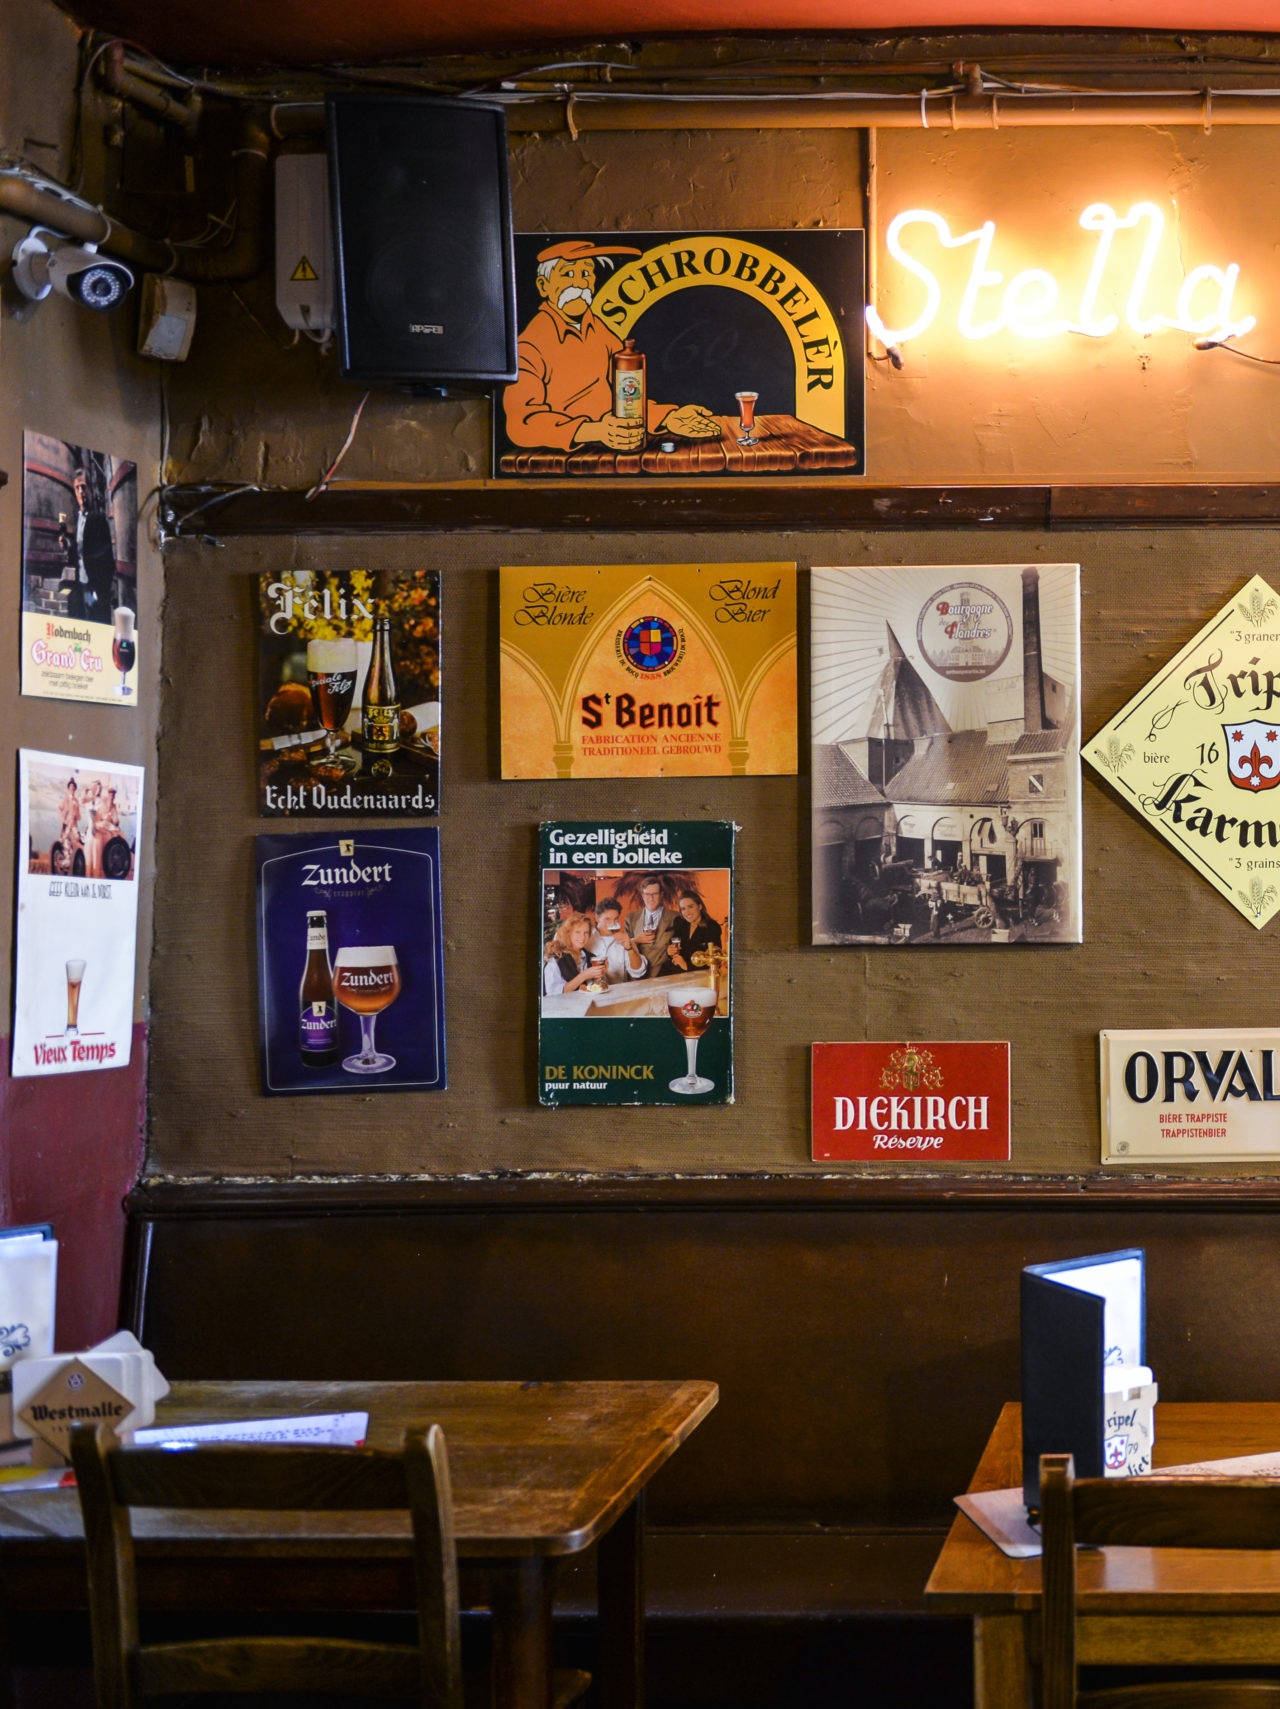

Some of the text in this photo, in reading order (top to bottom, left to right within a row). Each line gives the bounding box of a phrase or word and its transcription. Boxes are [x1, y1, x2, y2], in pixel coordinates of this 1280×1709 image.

[868, 203, 1256, 338] Stella
[600, 246, 838, 394] SCHROBBELÈR
[267, 582, 375, 635] Felix
[513, 582, 594, 626] Bière Blonde
[708, 579, 782, 624] Blond Bier
[46, 622, 91, 644] Rodenbach
[32, 639, 104, 672] Grand Cru
[582, 692, 720, 730] St Benoît
[582, 733, 720, 744] FABRICATION ANCIENNE
[582, 744, 722, 757] TRADITIONEEL GEBROUWD
[1142, 751, 1170, 764] bière
[1196, 742, 1220, 766] 16
[266, 783, 436, 810] Echt Oudenaards
[550, 828, 669, 849] Gezelligheid
[550, 848, 683, 865] in een bolleke
[301, 859, 392, 886] Zundert
[341, 968, 394, 987] Zundert
[34, 1040, 116, 1066] Vieux Temps
[545, 1064, 655, 1080] DE KONINCK
[544, 1080, 608, 1092] puur natuur
[832, 1096, 990, 1131] DIEKIRCH
[1159, 1112, 1228, 1124] BIÈRE TRAPPISTE
[872, 1134, 944, 1152] Réserve
[1160, 1127, 1228, 1139] TRAPPISTENBIER
[30, 1402, 124, 1422] Westmalle
